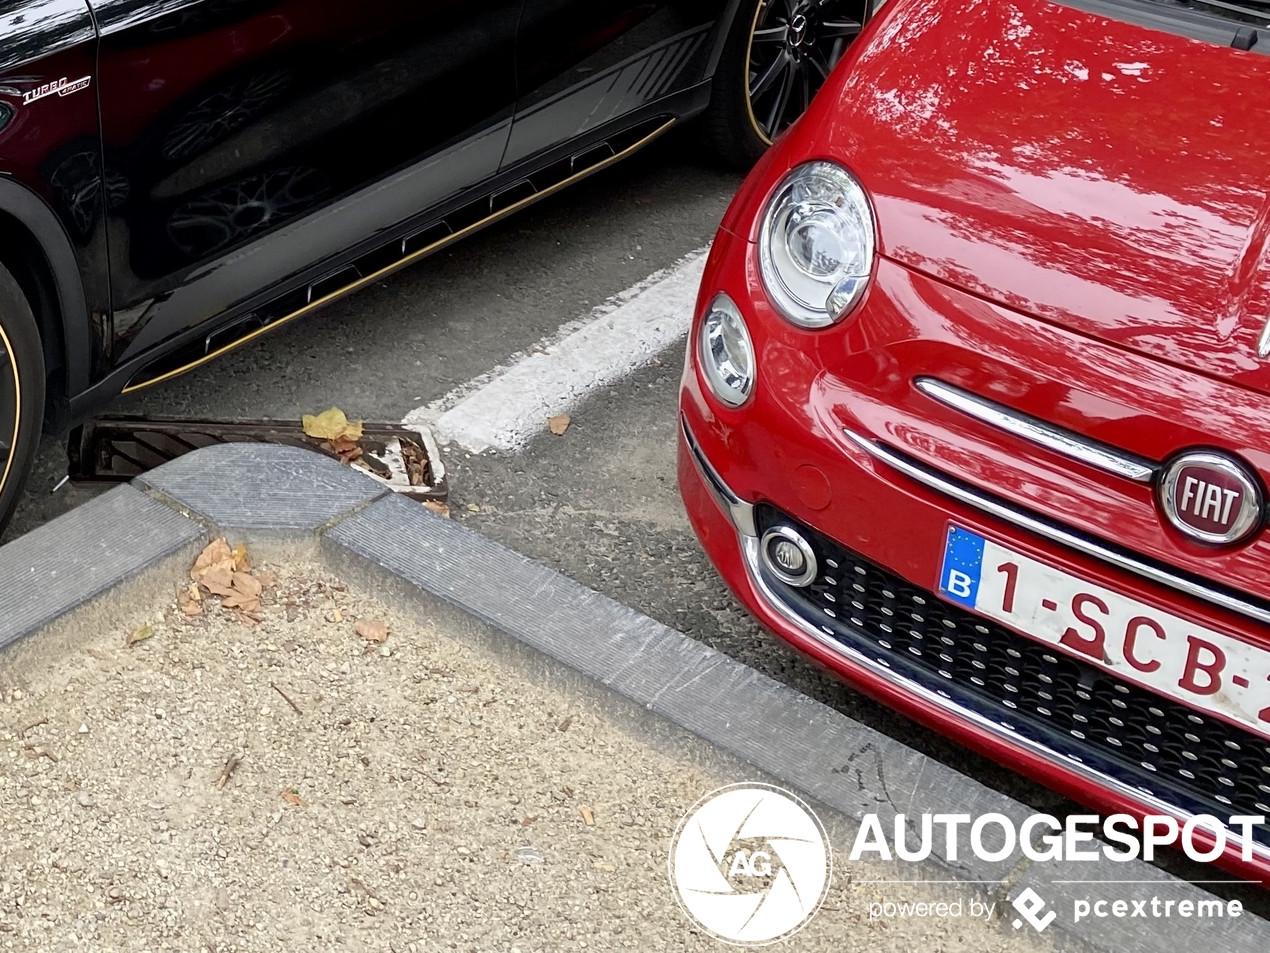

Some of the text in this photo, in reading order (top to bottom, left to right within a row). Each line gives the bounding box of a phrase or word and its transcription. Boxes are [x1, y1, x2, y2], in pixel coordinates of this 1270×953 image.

[22, 77, 67, 101] TURBO
[1180, 475, 1240, 526] FIAT
[947, 569, 972, 599] B
